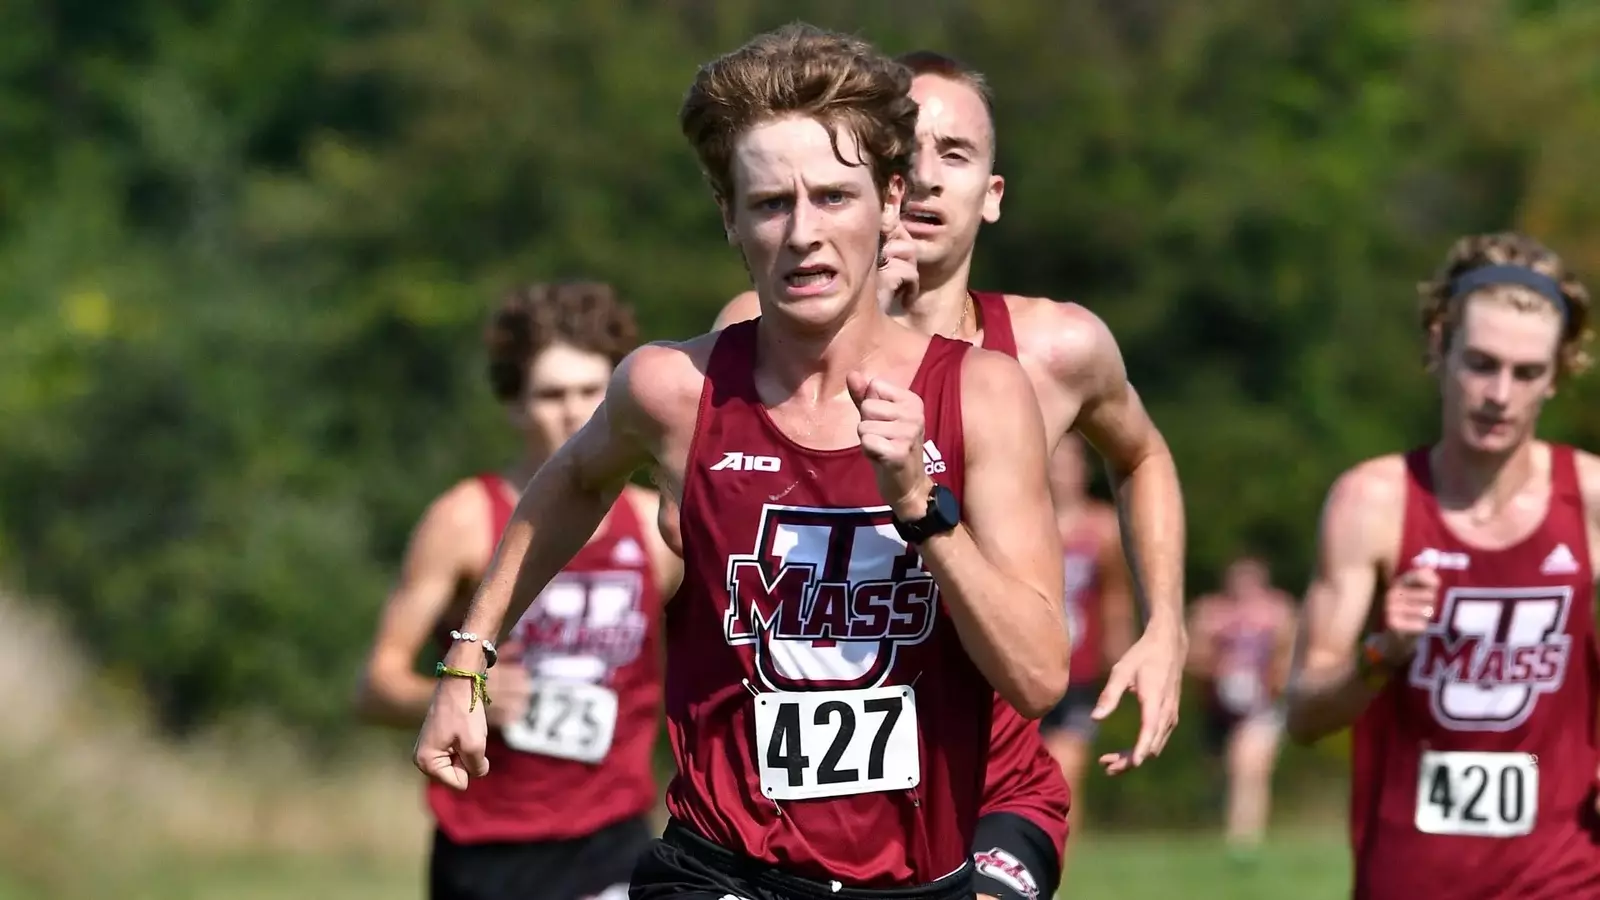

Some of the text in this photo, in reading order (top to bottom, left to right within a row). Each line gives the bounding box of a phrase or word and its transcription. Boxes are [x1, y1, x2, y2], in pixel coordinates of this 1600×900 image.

[709, 451, 782, 472] A10
[924, 461, 947, 475] das
[724, 555, 938, 645] MASS
[1410, 627, 1571, 690] MASS
[766, 696, 903, 787] 427
[1429, 764, 1525, 823] 420
